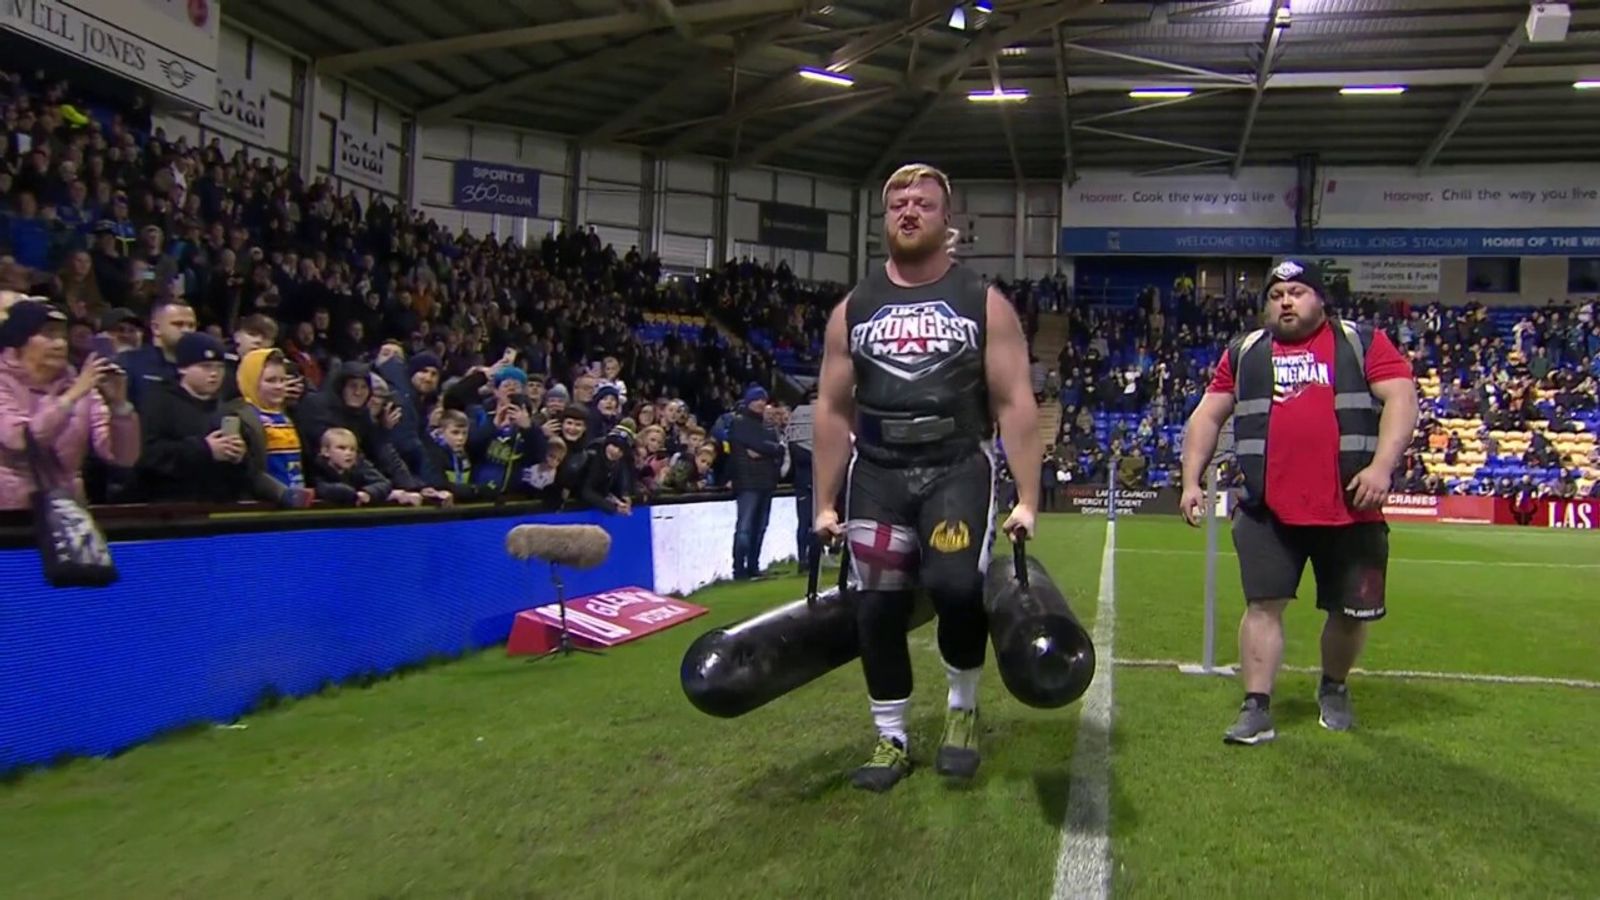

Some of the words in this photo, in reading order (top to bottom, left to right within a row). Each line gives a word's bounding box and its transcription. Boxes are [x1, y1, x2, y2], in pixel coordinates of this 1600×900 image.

[81, 22, 145, 70] JONES
[217, 79, 265, 128] otal
[340, 130, 383, 175] Total
[473, 167, 524, 183] SPORTS
[1132, 191, 1164, 203] Cook
[1168, 191, 1190, 203] the
[1193, 191, 1218, 205] way
[1223, 191, 1247, 205] you
[1252, 191, 1275, 203] live
[1383, 191, 1433, 202] Hoover.
[1442, 188, 1472, 201] Chill
[1478, 188, 1501, 201] the
[1508, 189, 1536, 203] way
[1541, 189, 1567, 203] you
[1572, 187, 1597, 200] live
[1176, 236, 1234, 247] WELCOME
[1240, 236, 1255, 247] TO
[1260, 236, 1281, 248] THE
[1367, 237, 1407, 248] JONES
[1413, 237, 1468, 248] STADIUM
[1482, 237, 1525, 248] HOME
[1527, 237, 1548, 247] OF
[1551, 236, 1578, 247] THE
[851, 315, 979, 352] STRONGEST
[873, 338, 949, 355] MAN
[1073, 498, 1102, 506] ENERGY
[1104, 499, 1142, 507] EICIENT
[1095, 490, 1121, 498] LAE
[1121, 490, 1158, 499] CAPACITY
[1387, 495, 1437, 505] CRANES
